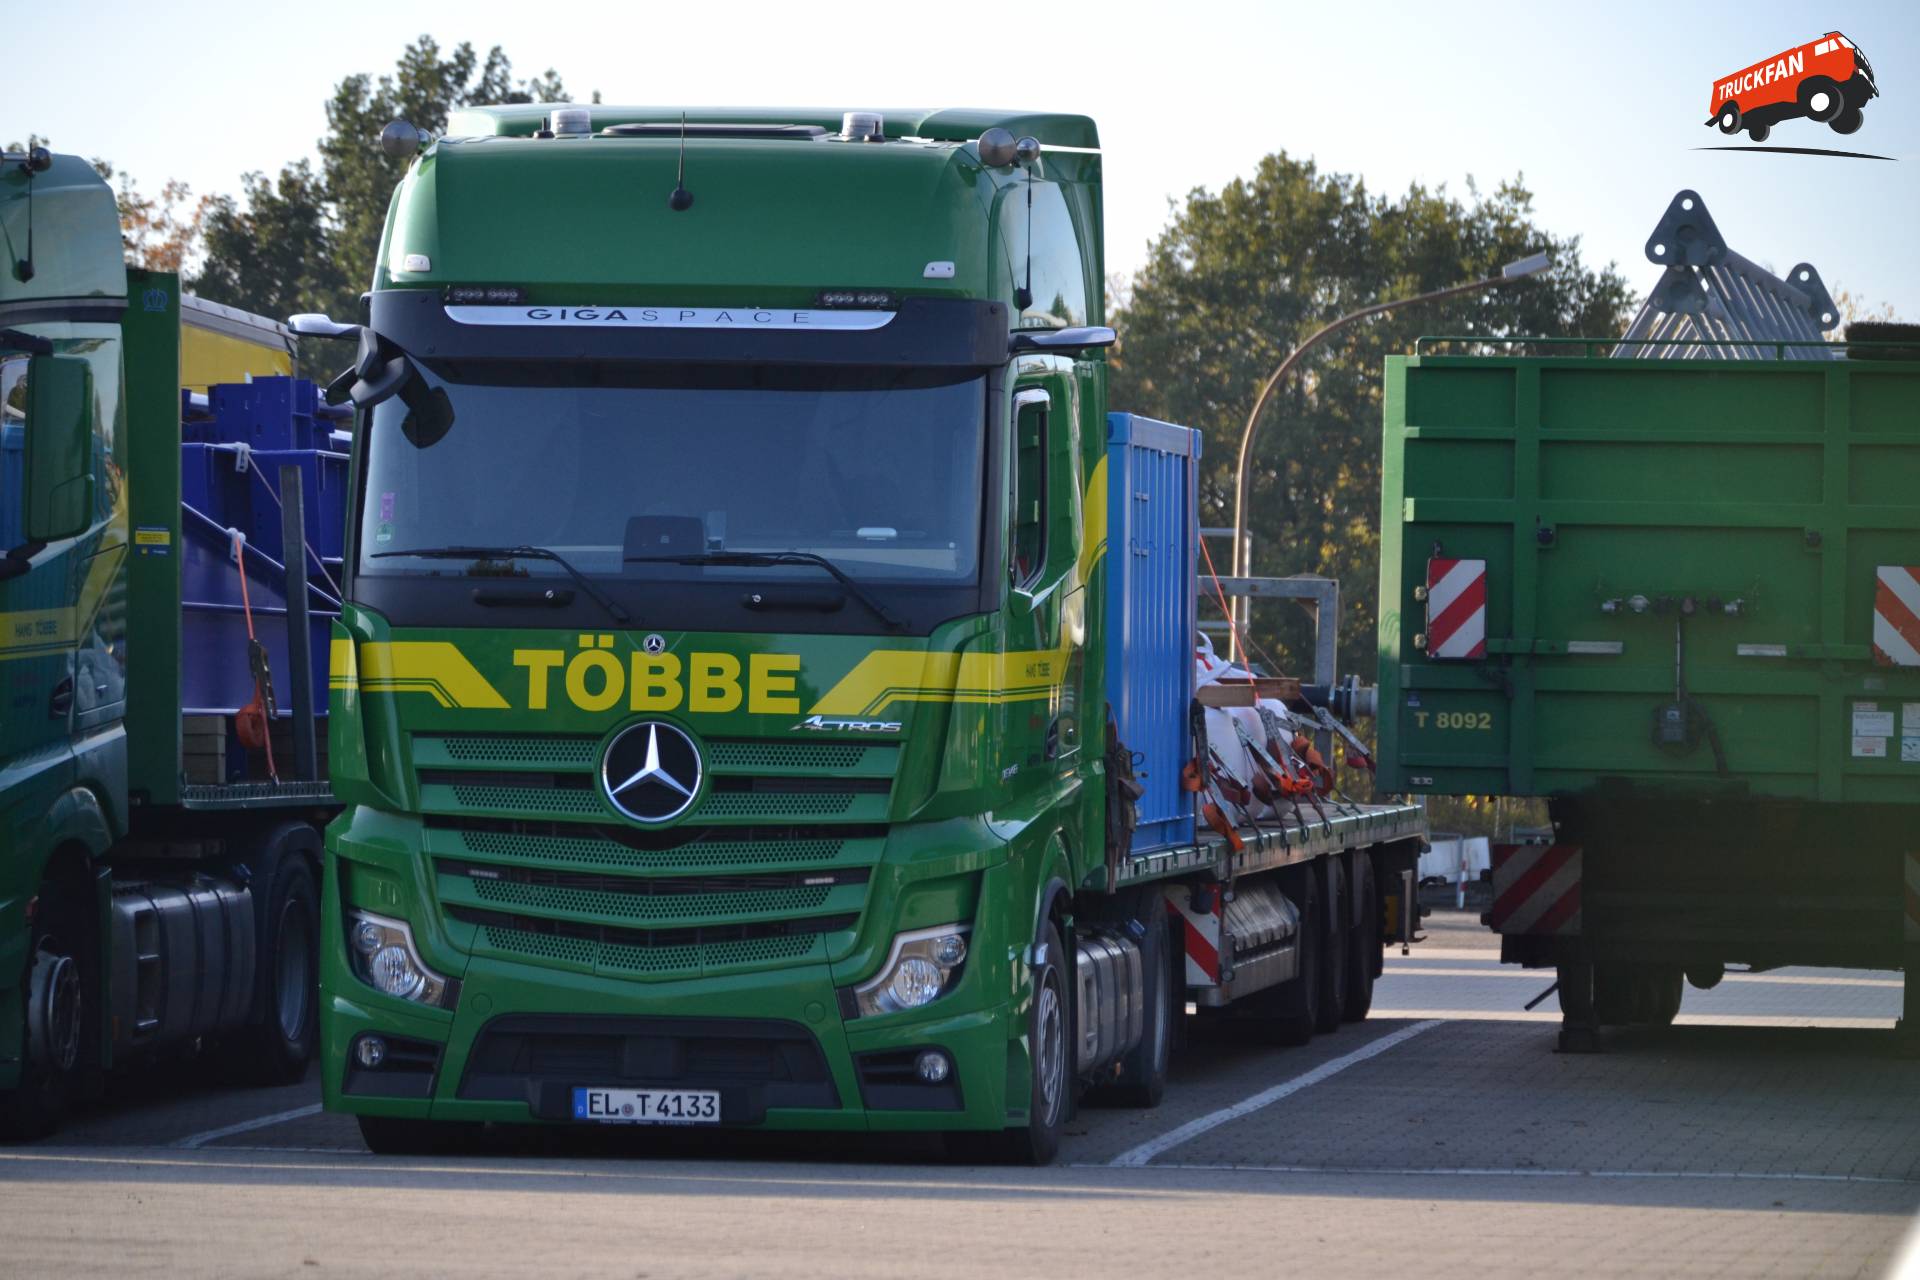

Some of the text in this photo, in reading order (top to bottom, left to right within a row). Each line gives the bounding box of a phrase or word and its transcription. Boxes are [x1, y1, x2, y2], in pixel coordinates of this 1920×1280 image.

[513, 633, 801, 714] TÖBBE
[1414, 711, 1492, 729] T 8092
[589, 1092, 716, 1118] EL T 4133
